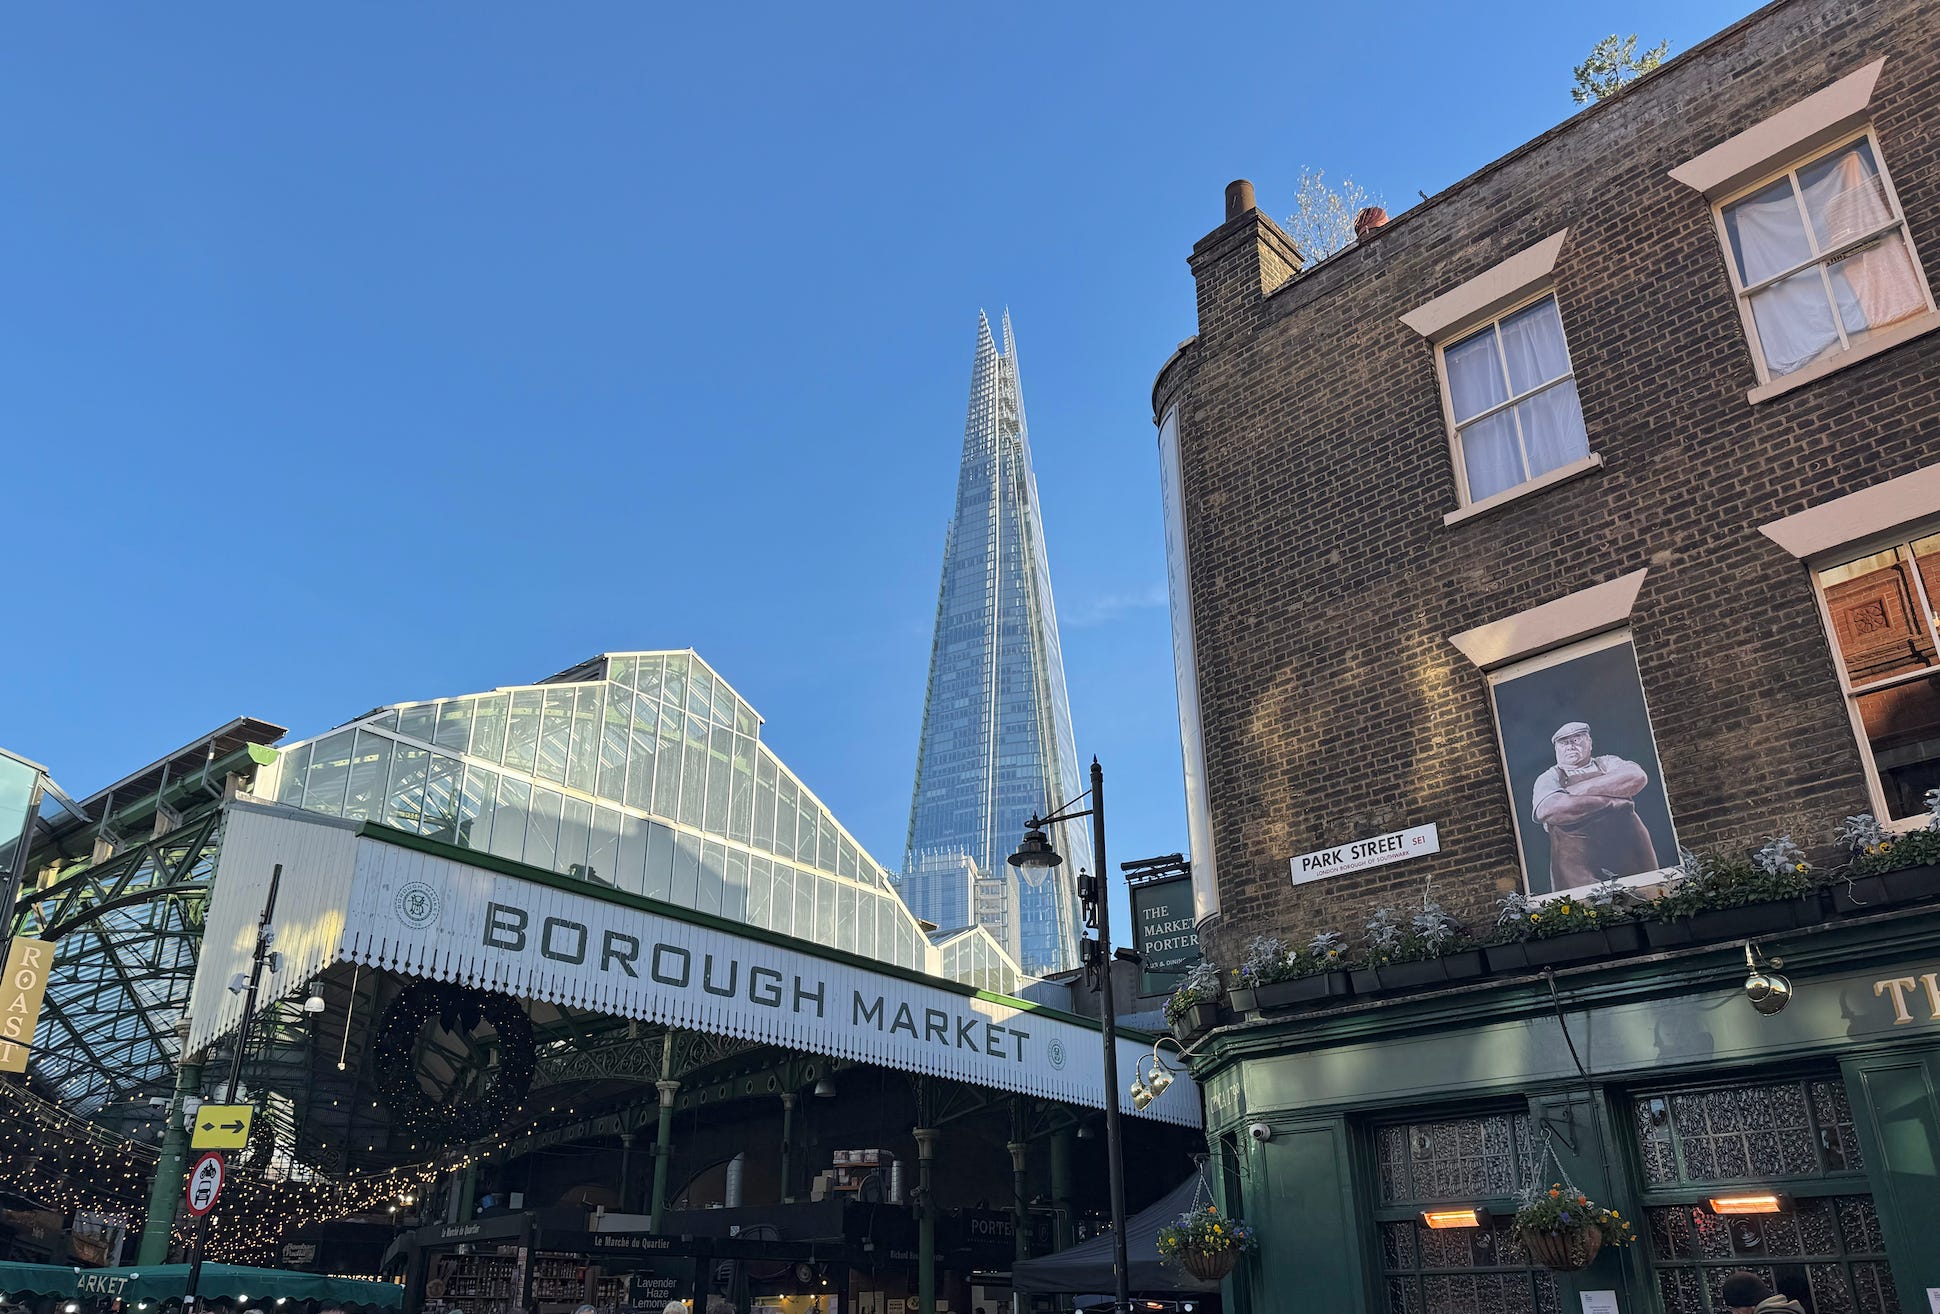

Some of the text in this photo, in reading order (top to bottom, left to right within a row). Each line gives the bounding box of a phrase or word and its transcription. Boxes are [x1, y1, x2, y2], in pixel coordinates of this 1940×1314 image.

[1302, 834, 1426, 872] PARK STREET SE1
[1316, 867, 1340, 877] LONDON
[1339, 861, 1367, 873] BOROUGH
[1376, 850, 1410, 863] SOUTHWARK
[1143, 905, 1169, 920] THE
[1144, 917, 1196, 937] MARKET
[1145, 933, 1200, 954] PORTER
[482, 901, 1030, 1063] BOROUGH MARKET
[0, 945, 42, 1064] ROAST
[971, 1219, 1016, 1237] PORTE
[594, 1235, 671, 1250] Le Marché du Quartier
[636, 1276, 678, 1288] Lavender
[646, 1287, 670, 1298] Haze
